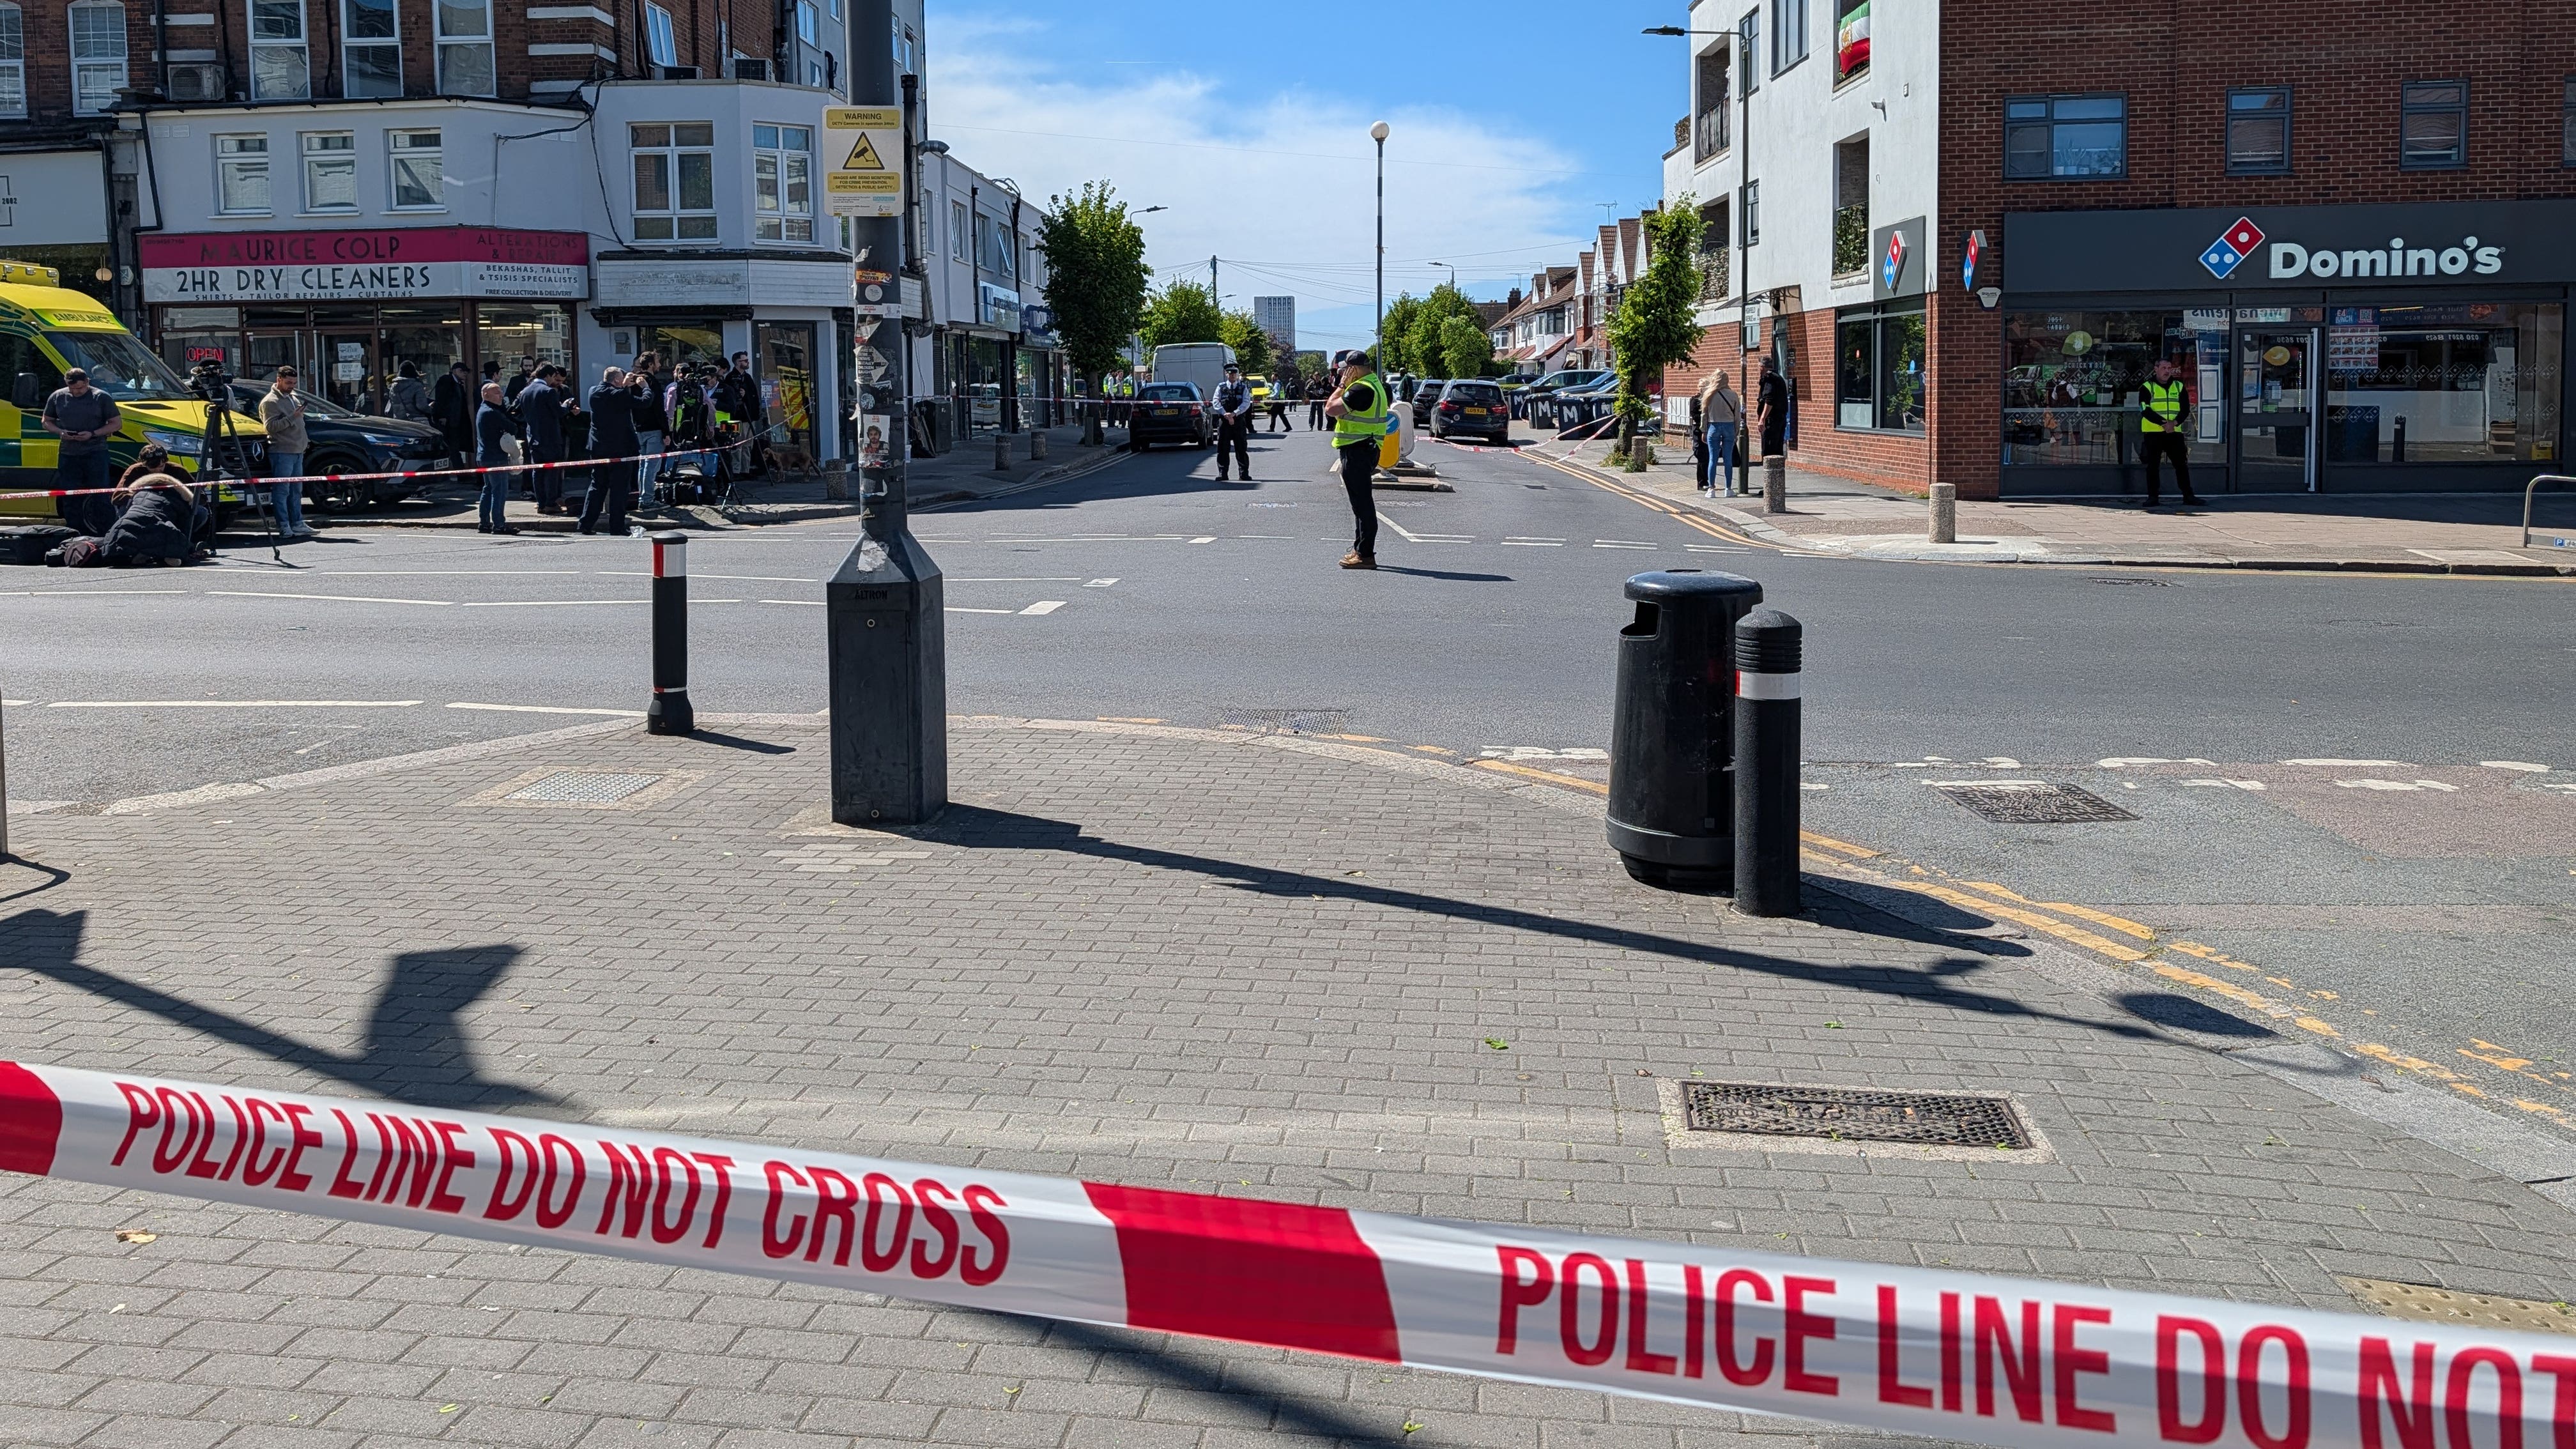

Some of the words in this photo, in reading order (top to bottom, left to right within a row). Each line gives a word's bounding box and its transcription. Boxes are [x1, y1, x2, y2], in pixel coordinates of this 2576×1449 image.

[200, 238, 316, 262] MAURICE
[334, 236, 400, 259] COLP
[477, 234, 578, 249] ALTERATIONS
[492, 249, 499, 259] &
[2268, 235, 2503, 279] Domino's
[486, 264, 537, 274] BEKASHAS,
[177, 270, 220, 293] 2HR
[237, 268, 283, 291] DRY
[302, 266, 430, 289] CLEANERS
[521, 275, 578, 284] SPECIALISTS
[53, 313, 115, 325] AMBULANCE
[187, 347, 224, 362] OPEN
[1538, 401, 1551, 417] M
[1563, 406, 1578, 423] M
[112, 1083, 322, 1192] POLICE
[328, 1110, 475, 1214] LINE
[484, 1128, 585, 1229] DO
[595, 1142, 734, 1249] NOT
[763, 1161, 1009, 1287] CROSS
[1497, 1245, 1838, 1395] POLICE
[1878, 1285, 2115, 1433] LINE
[2156, 1316, 2310, 1449] DO
[2358, 1338, 2576, 1449] NOT
